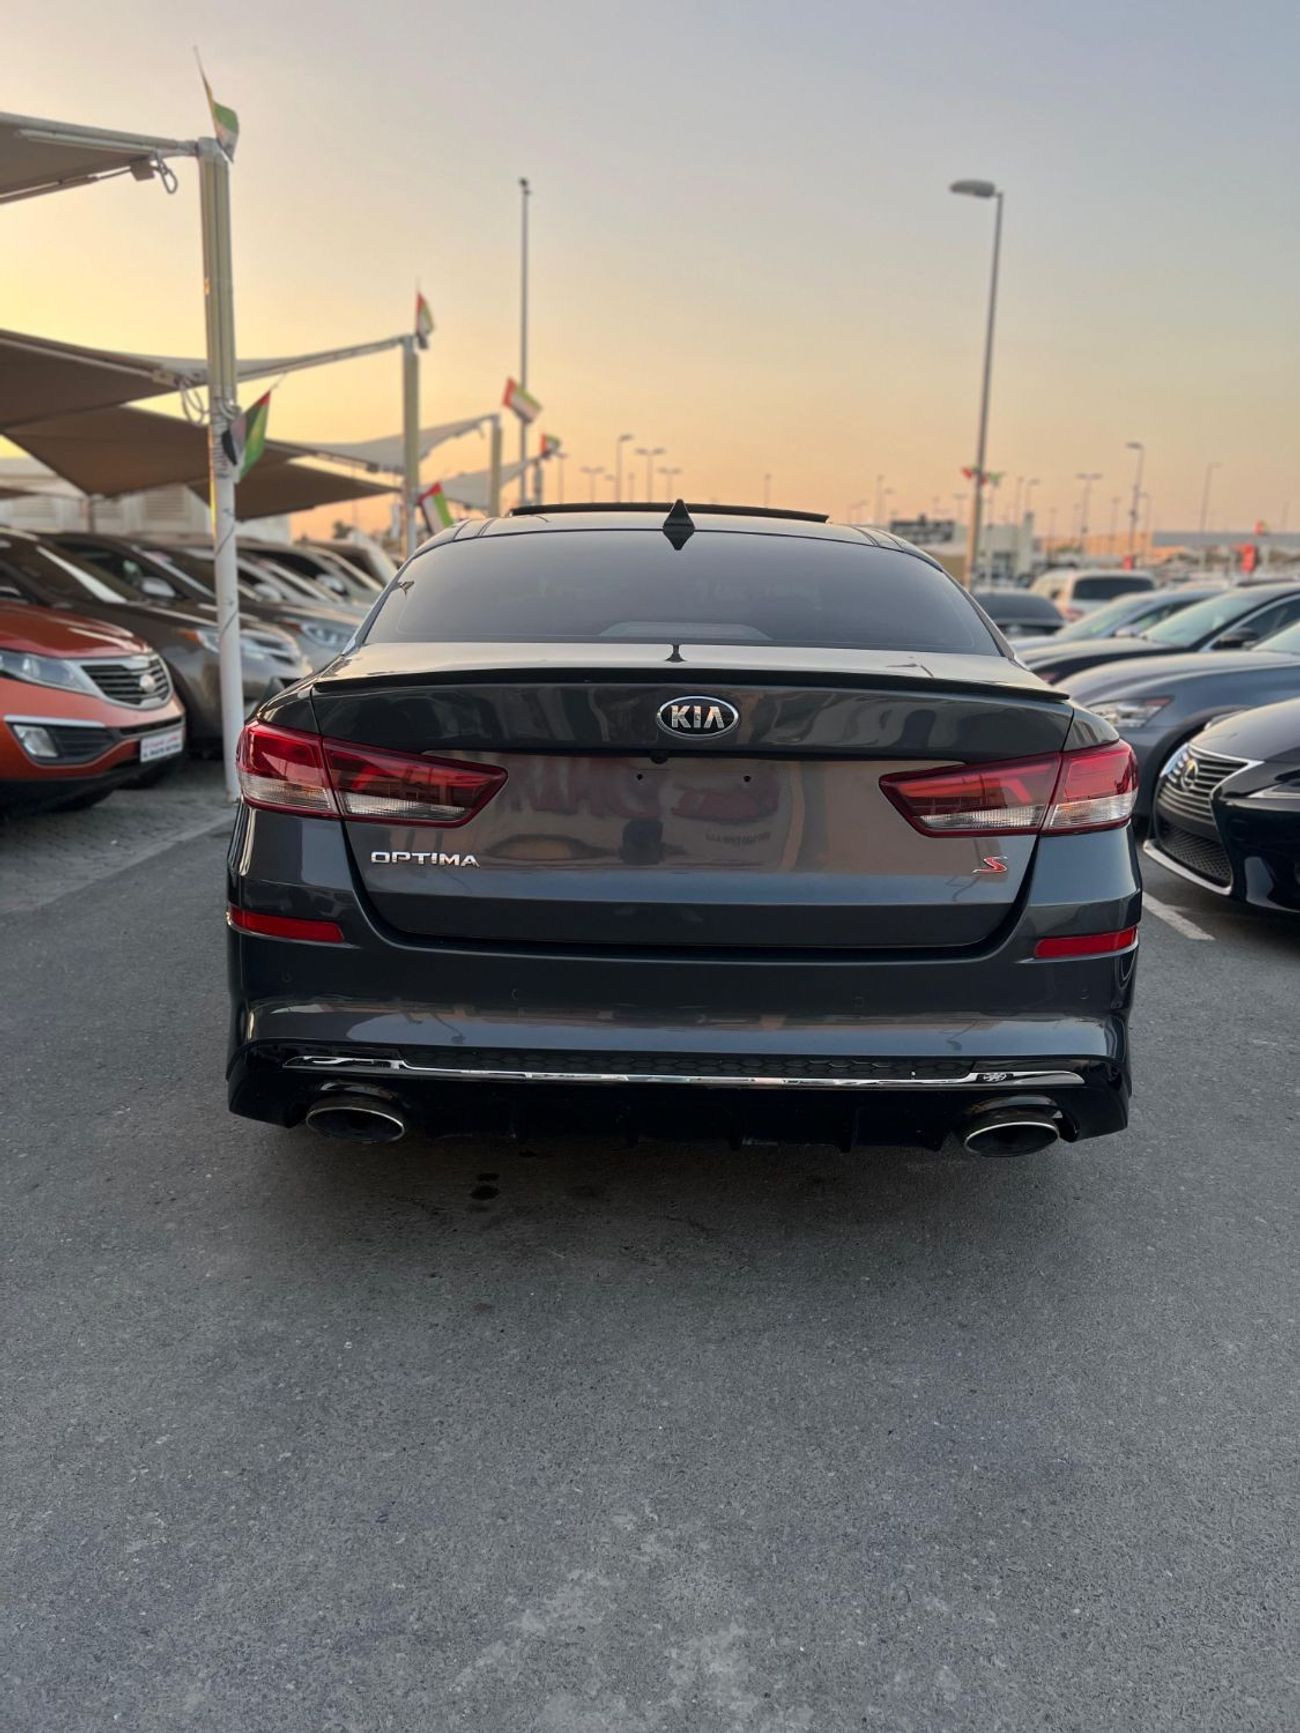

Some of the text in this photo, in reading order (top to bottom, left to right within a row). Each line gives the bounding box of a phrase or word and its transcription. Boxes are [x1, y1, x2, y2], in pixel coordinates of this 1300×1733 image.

[671, 705, 725, 728] KIA
[371, 851, 480, 868] OPTIMA
[972, 856, 1008, 873] S
